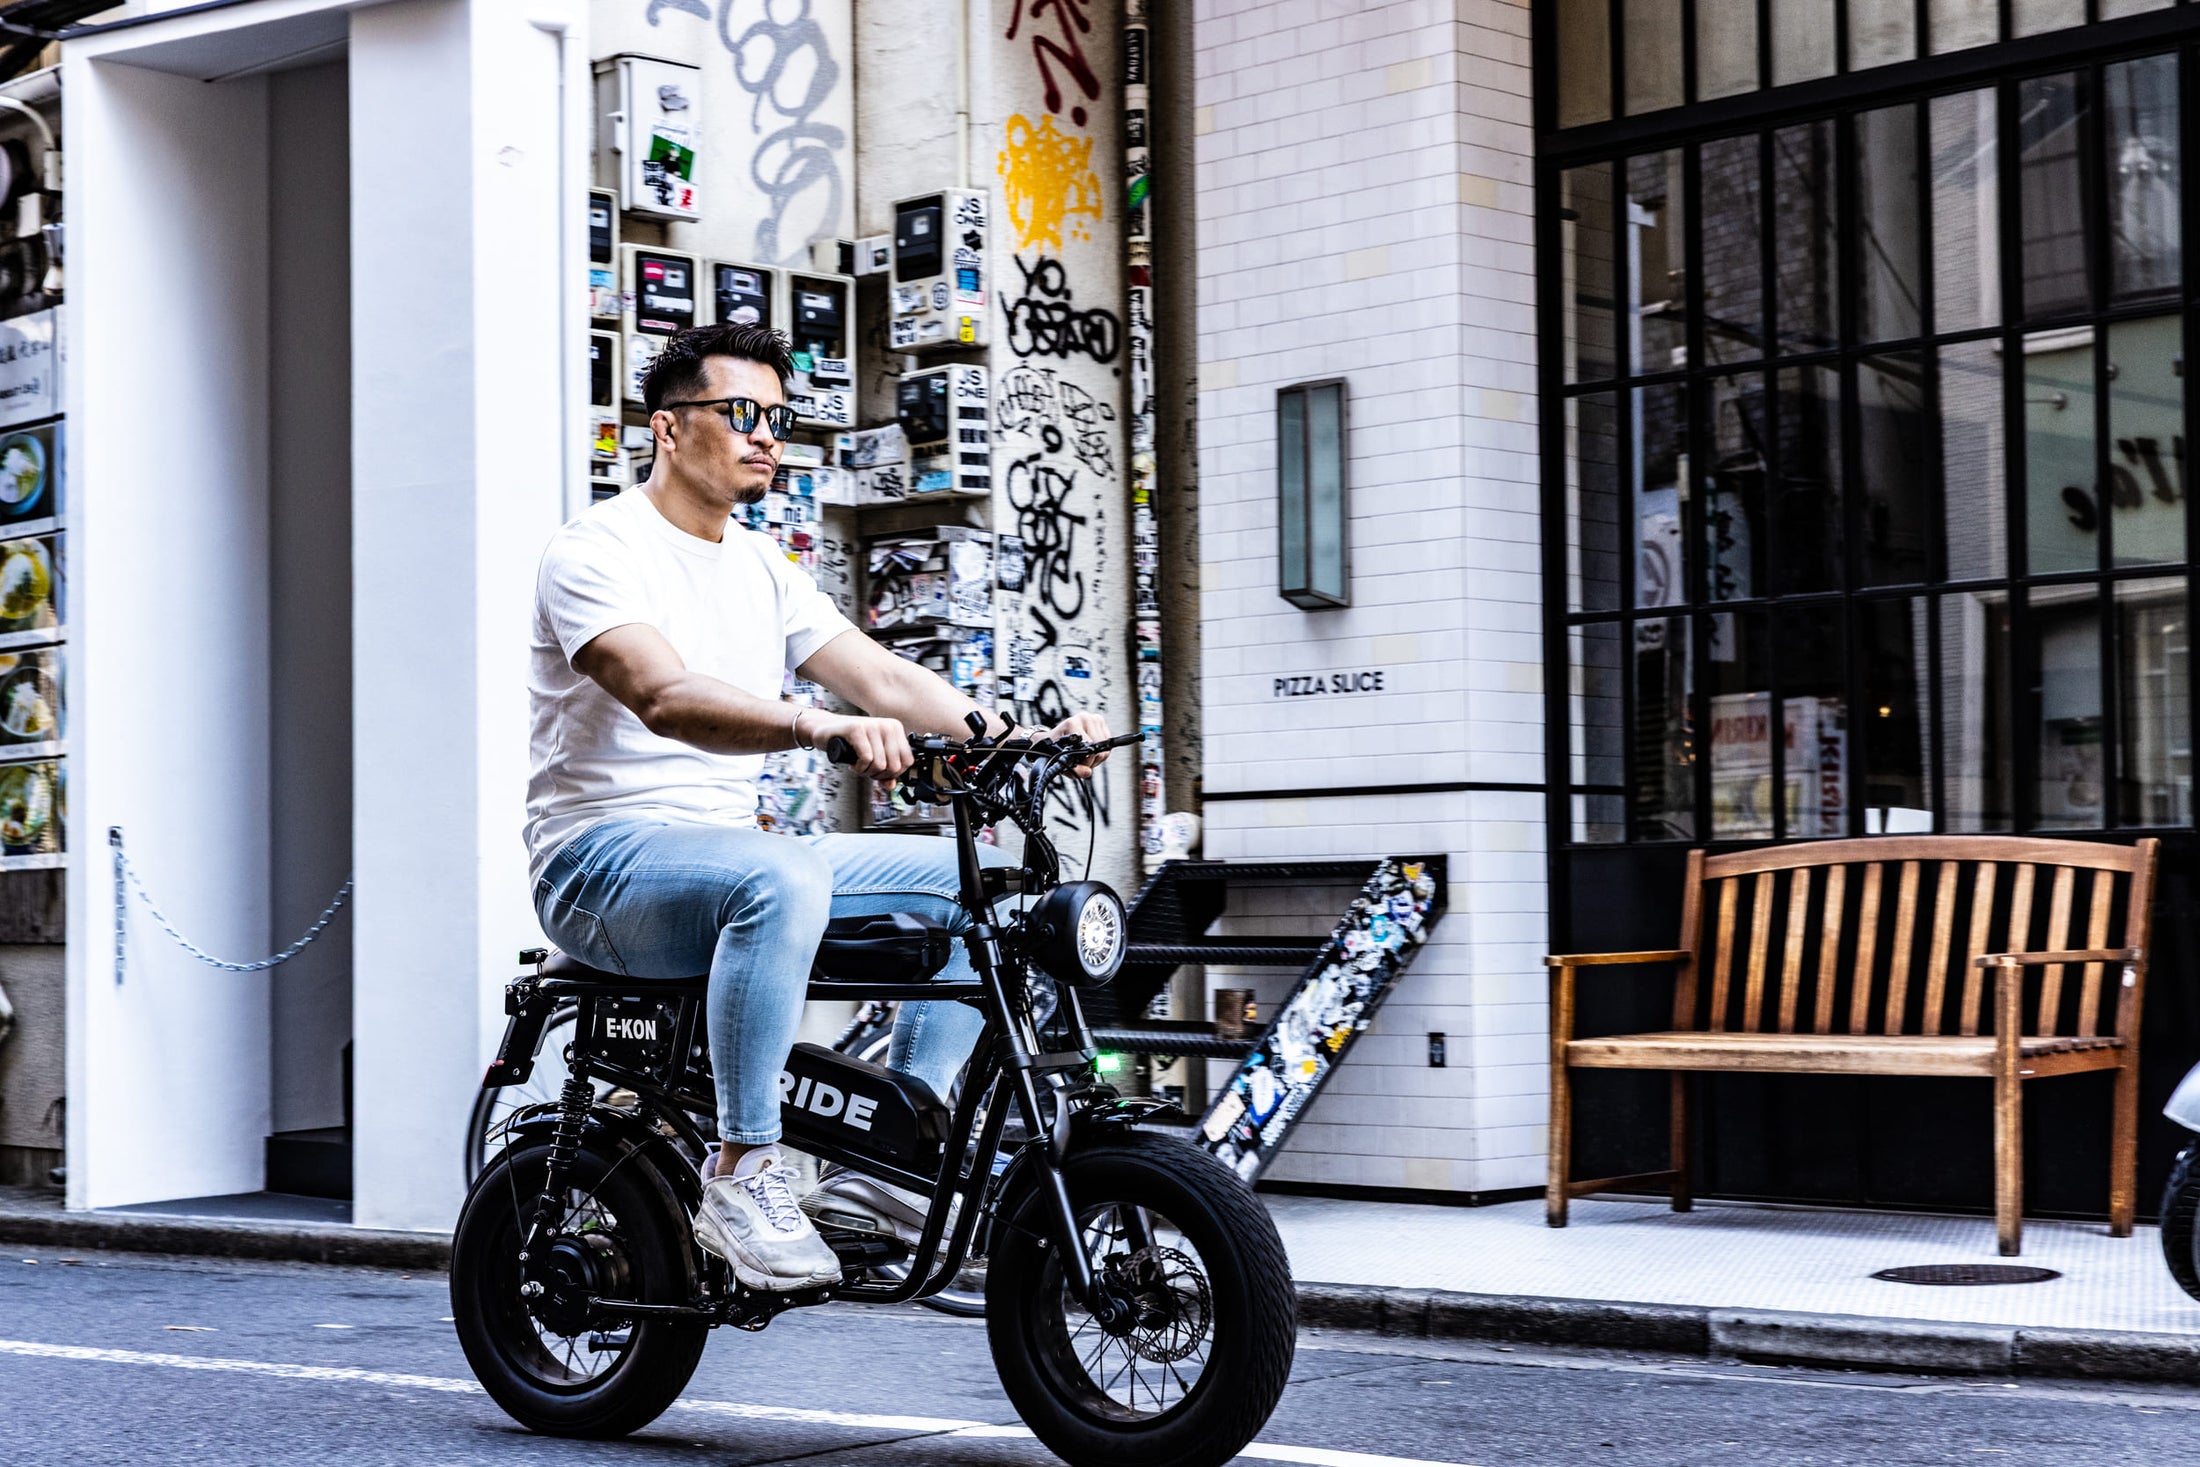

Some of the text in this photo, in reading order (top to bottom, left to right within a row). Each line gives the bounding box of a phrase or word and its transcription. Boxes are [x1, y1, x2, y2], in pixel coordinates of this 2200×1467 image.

[958, 197, 981, 214] JS
[954, 213, 987, 228] ONE
[958, 370, 983, 386] JS
[955, 386, 988, 399] ONE
[821, 394, 845, 410] JS
[816, 410, 848, 424] ONE
[1274, 671, 1384, 698] PIZZA SLICE
[606, 1017, 657, 1041] E-KON
